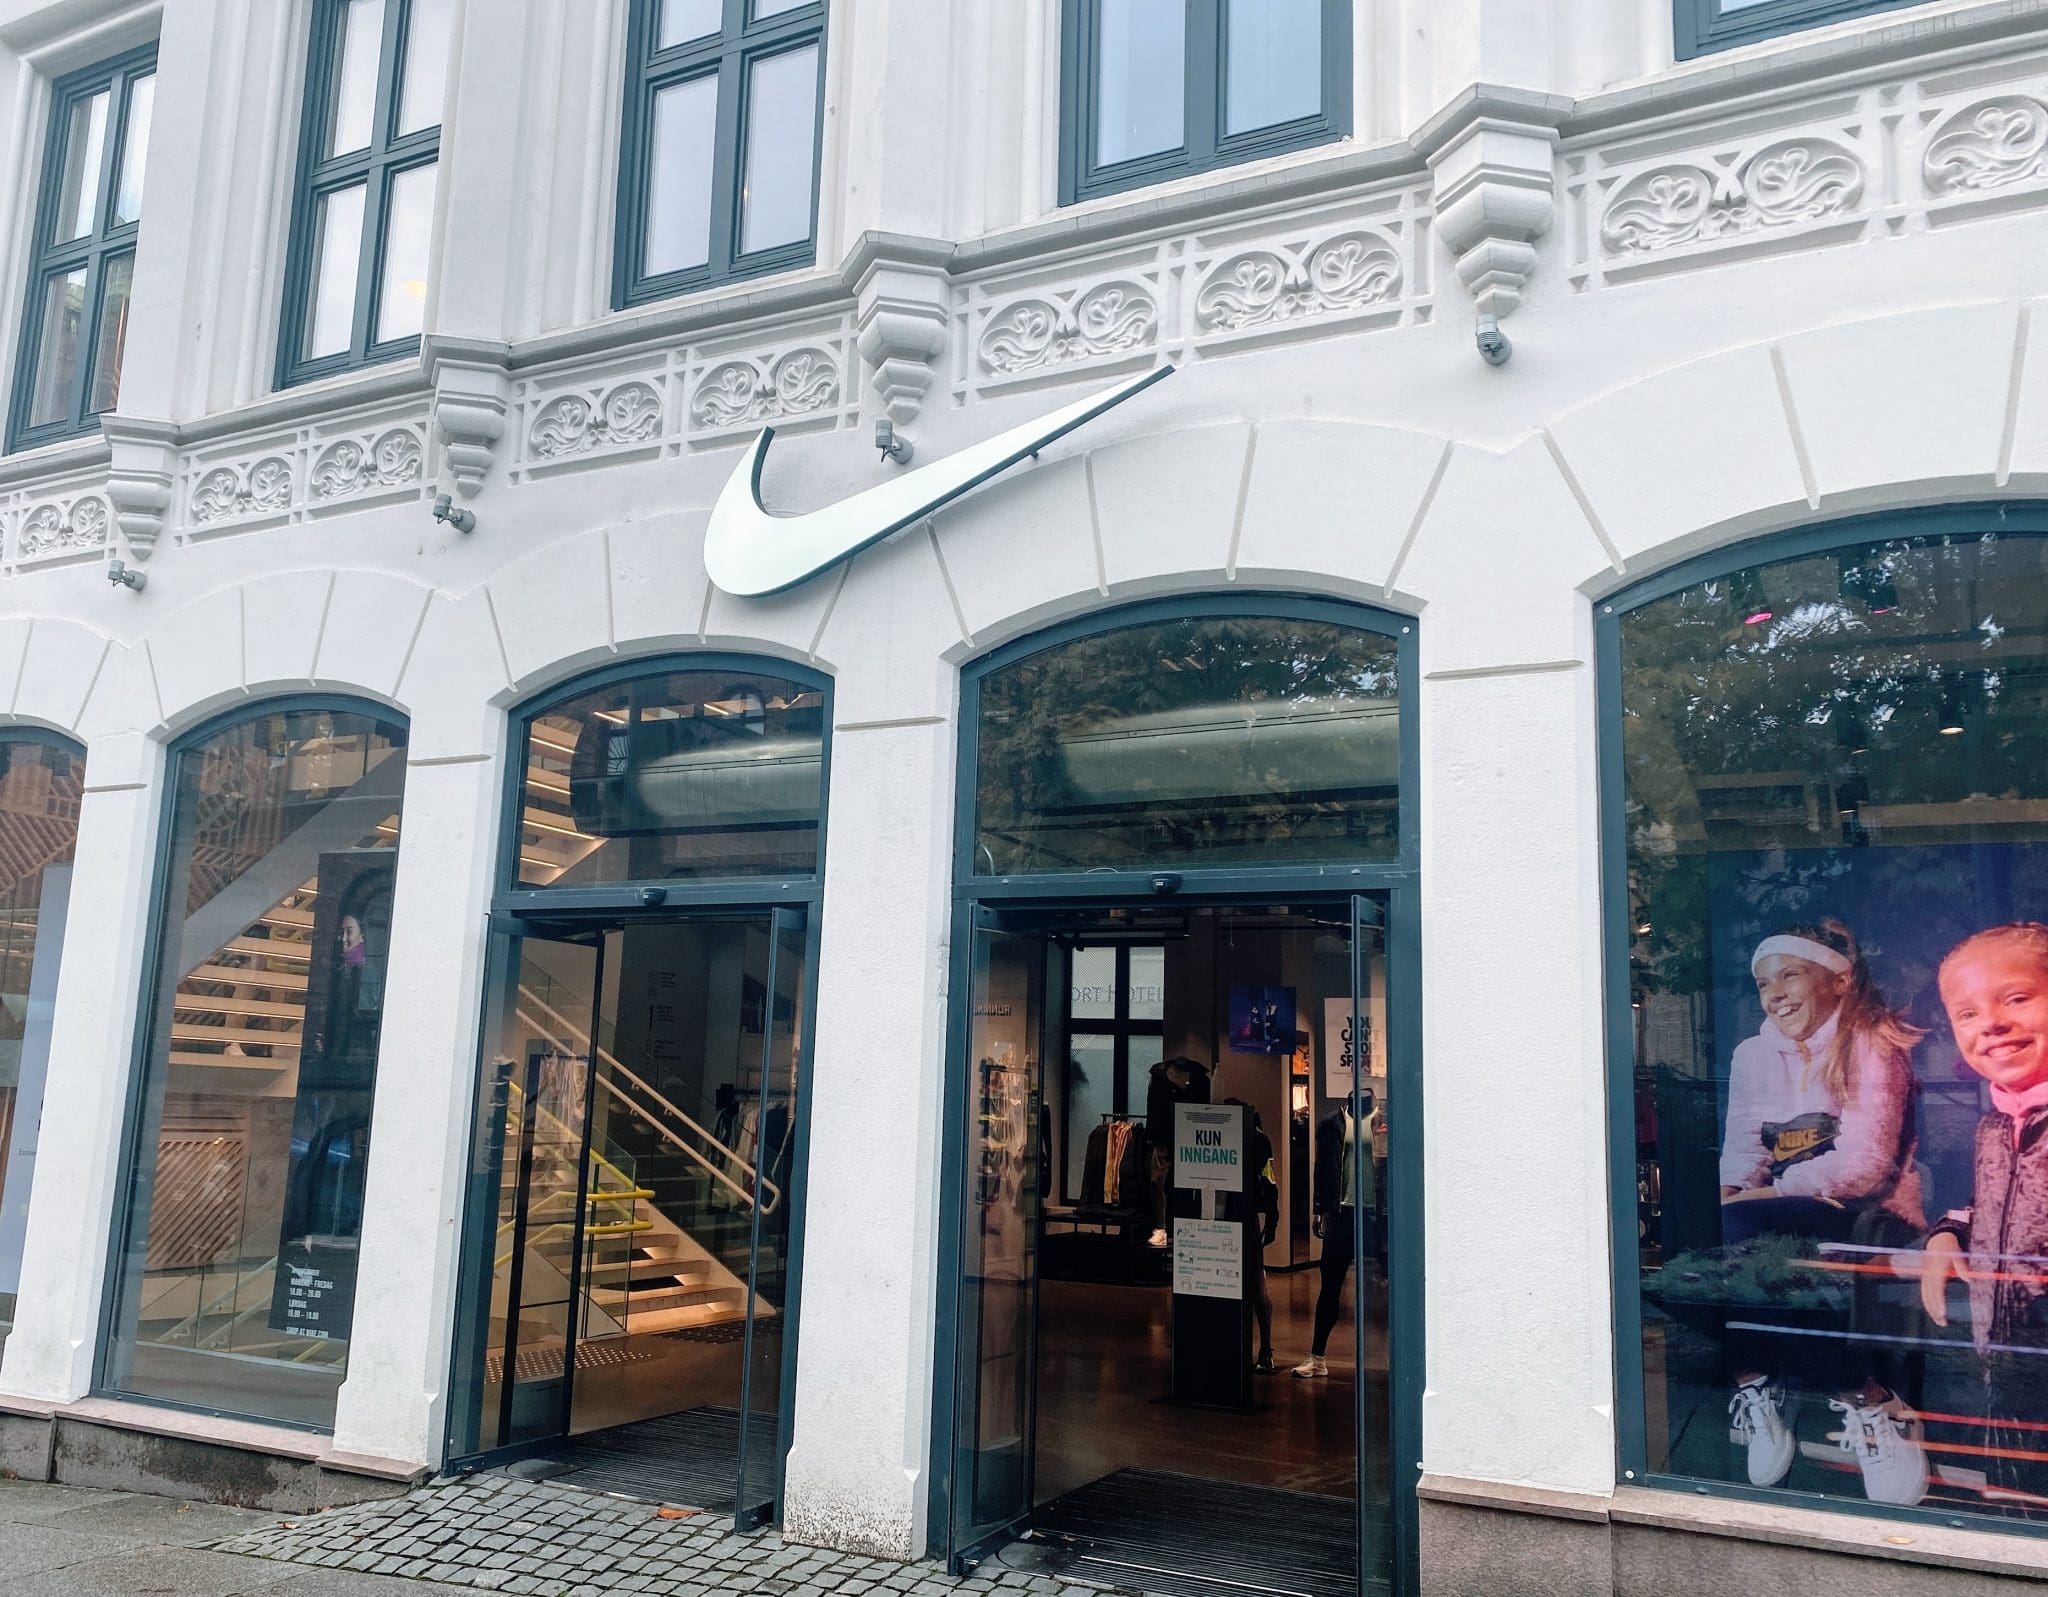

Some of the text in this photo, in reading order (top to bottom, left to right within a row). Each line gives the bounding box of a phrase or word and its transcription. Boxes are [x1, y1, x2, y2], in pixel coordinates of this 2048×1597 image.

[1344, 1042, 1377, 1055] SOP
[1195, 1129, 1222, 1147] KUN
[1778, 1128, 1819, 1149] NIKE
[1180, 1146, 1238, 1166] INNGANG
